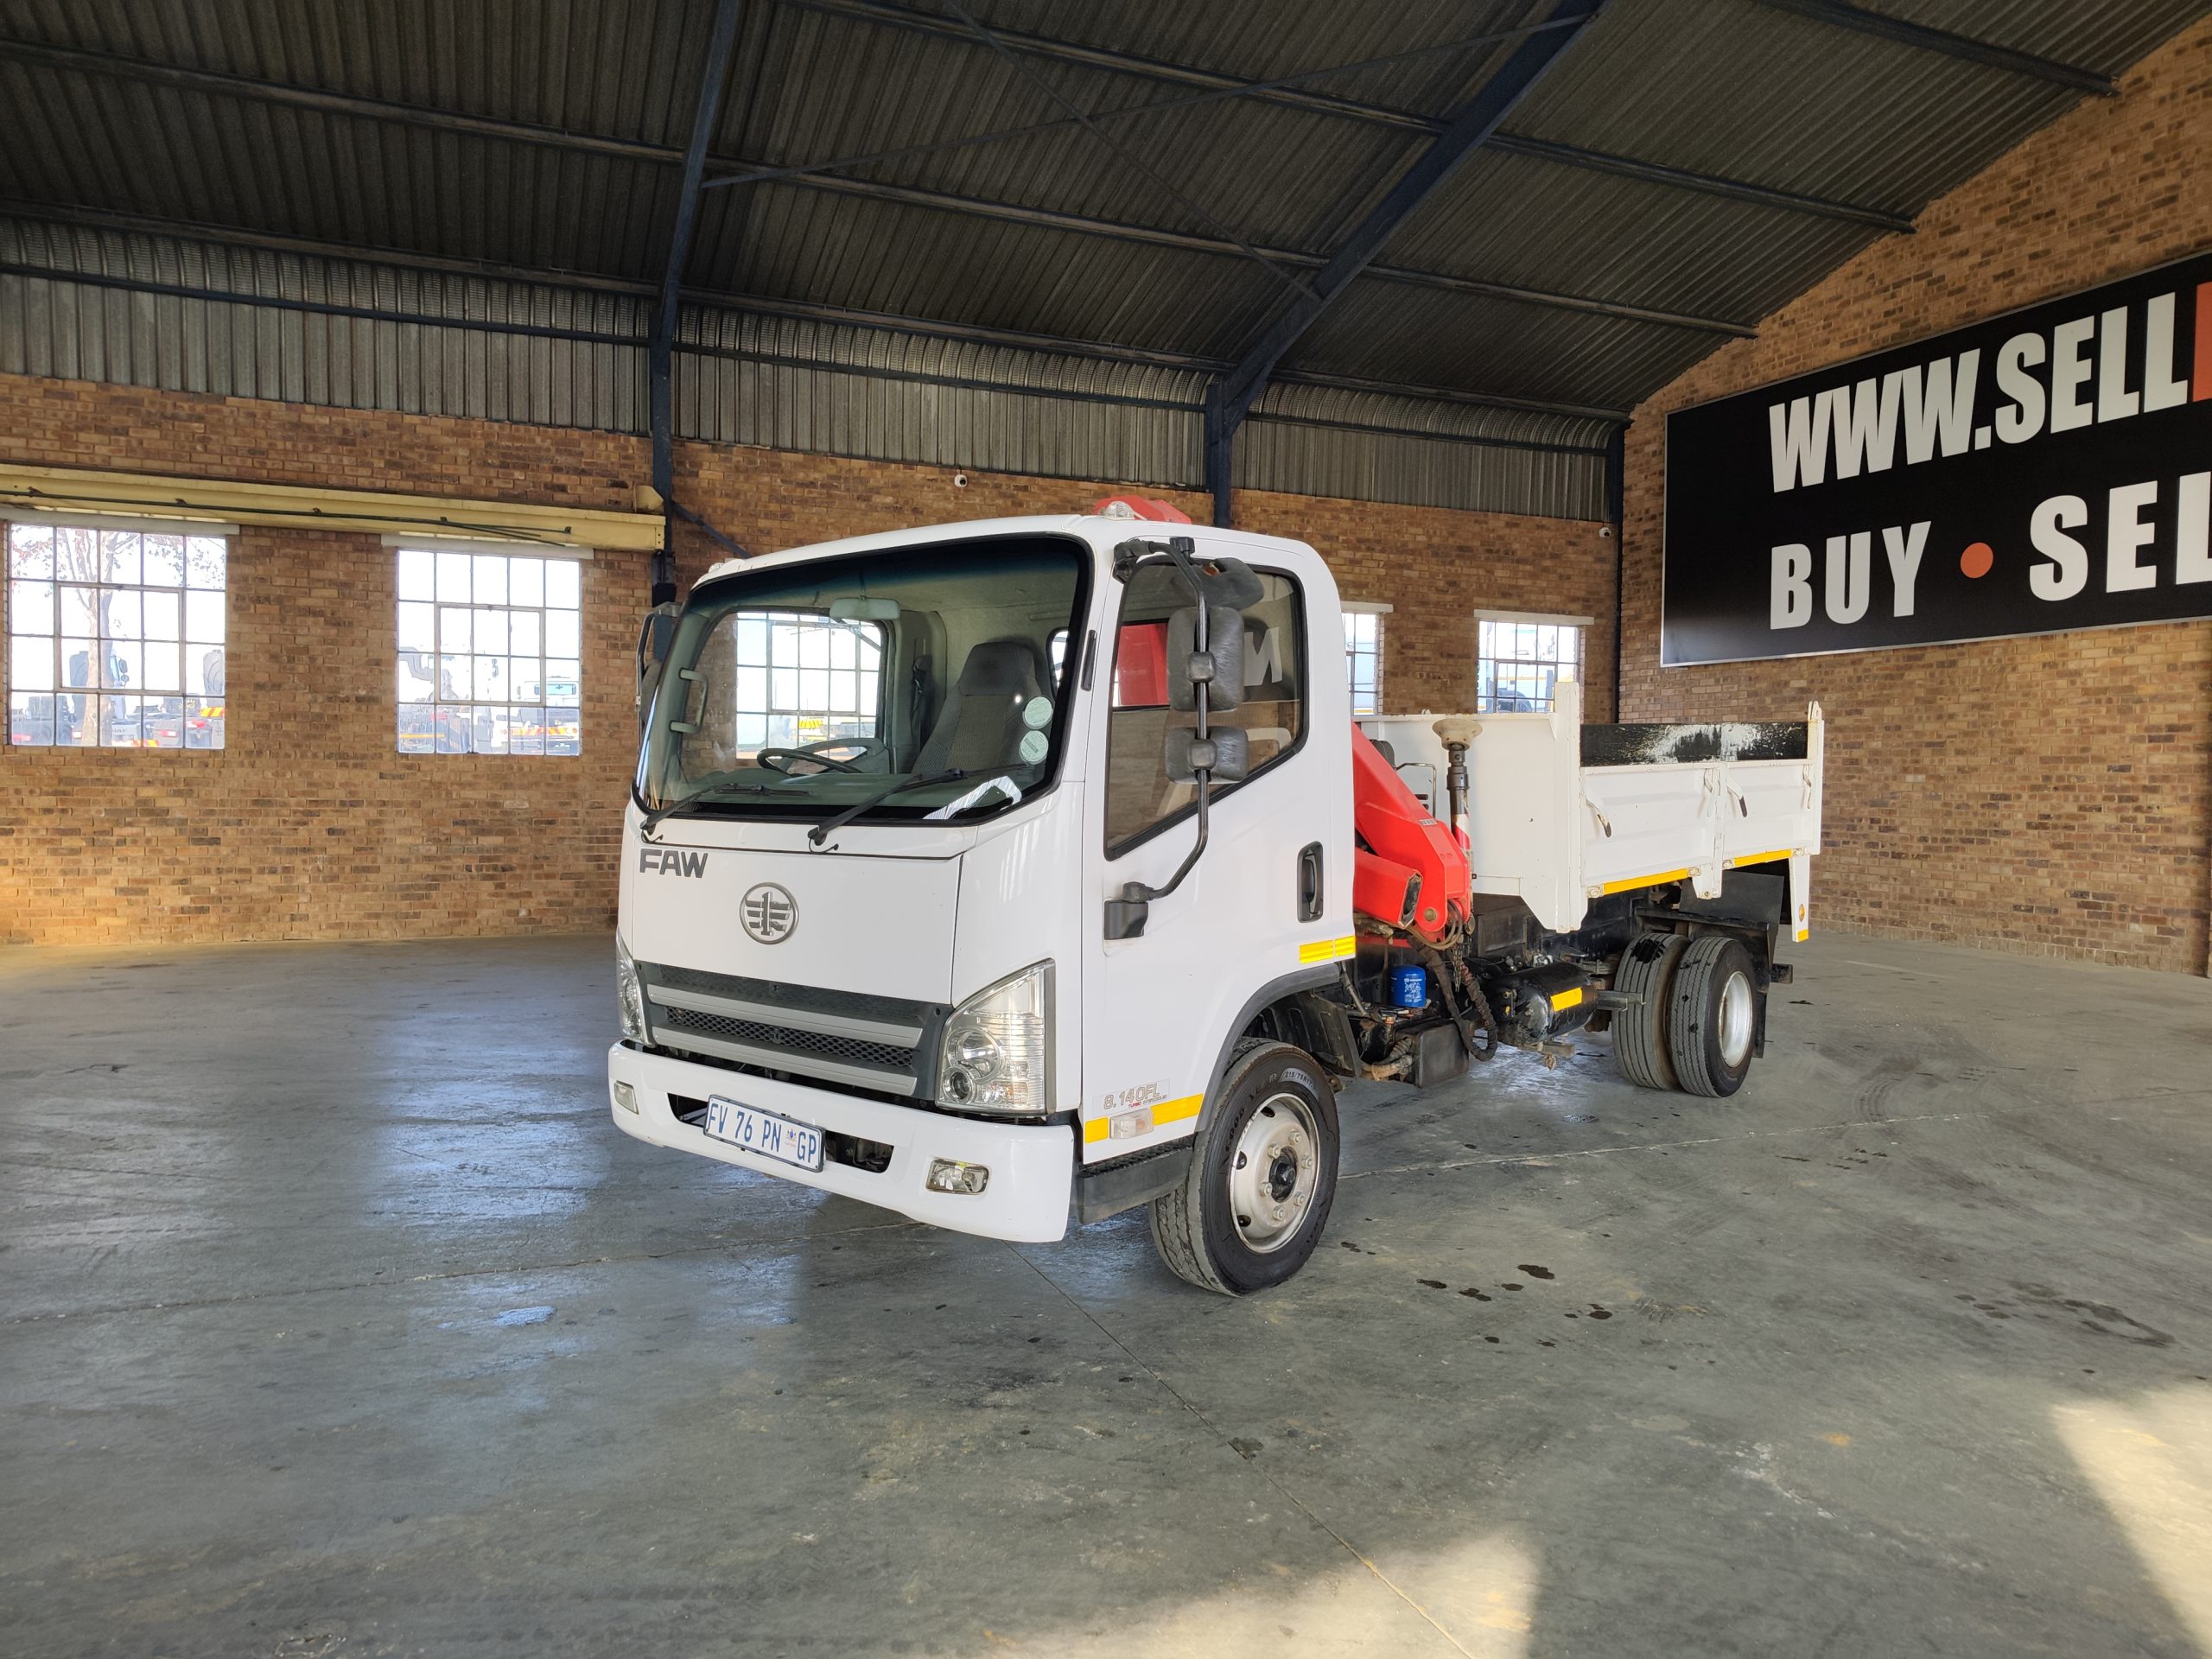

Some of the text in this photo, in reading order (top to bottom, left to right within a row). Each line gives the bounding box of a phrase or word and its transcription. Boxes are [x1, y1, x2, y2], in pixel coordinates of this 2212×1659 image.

[1770, 520, 1931, 630] BUY
[639, 848, 709, 879] FAW
[1103, 1083, 1160, 1110] 8.140FL
[708, 1103, 817, 1163] FV 76 PN GP
